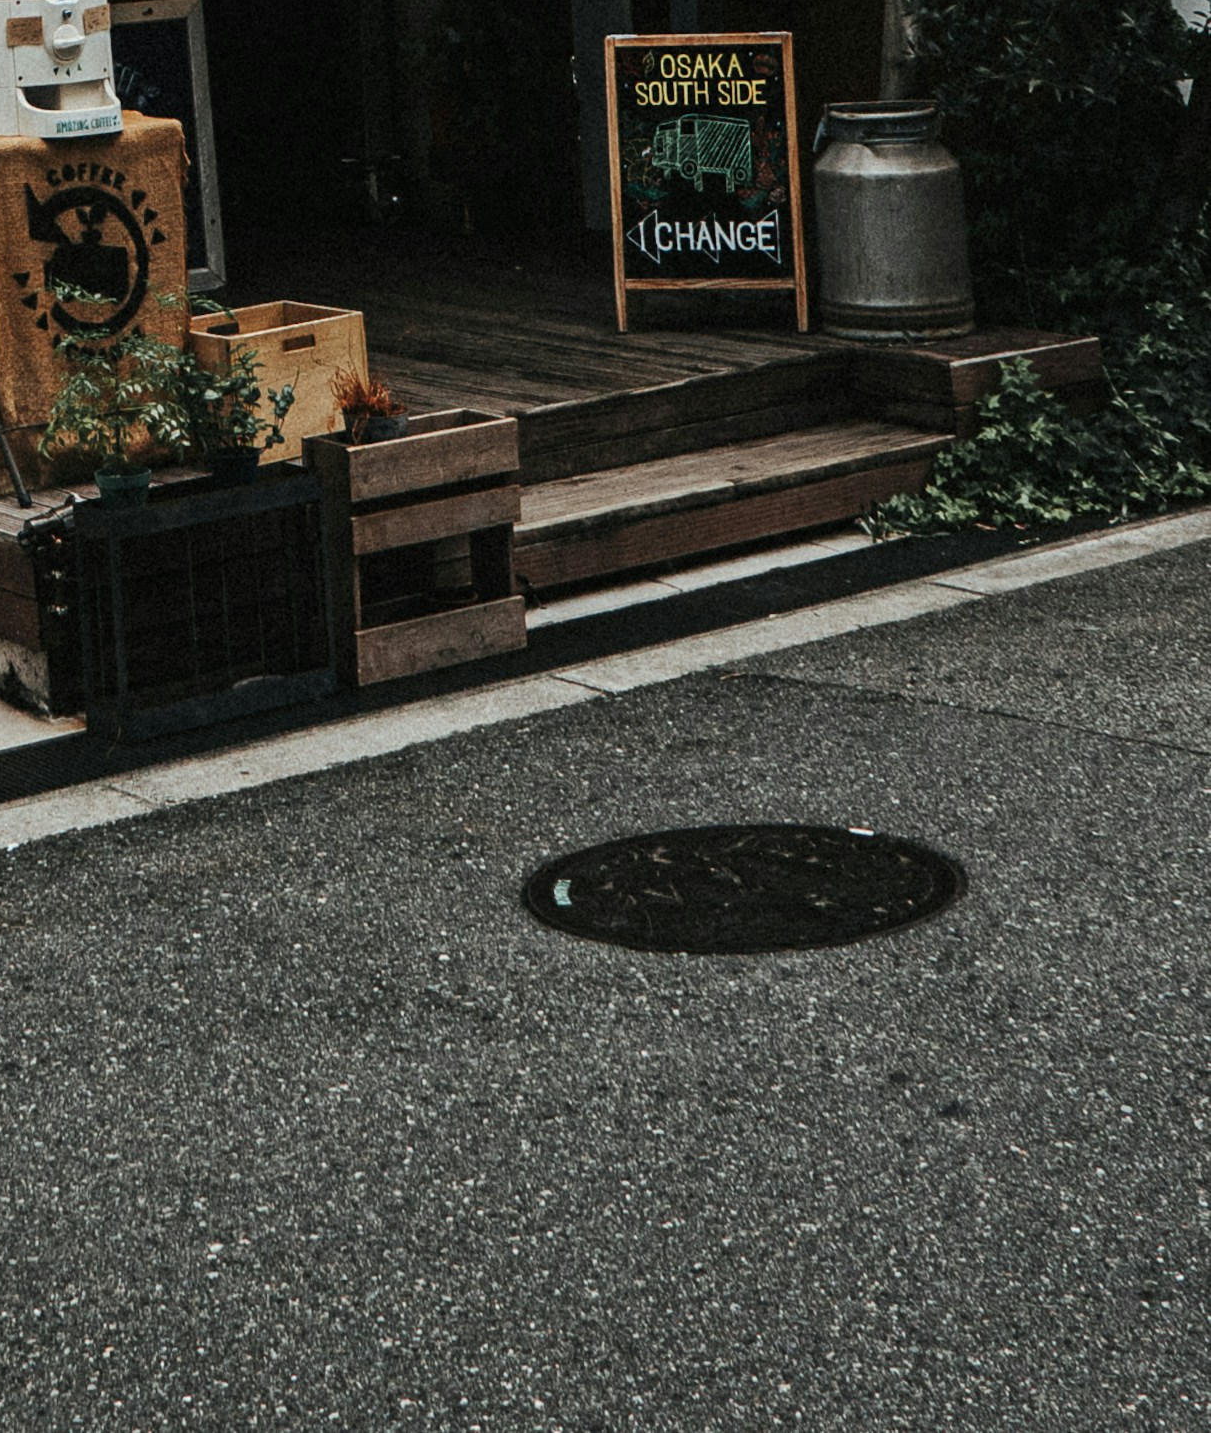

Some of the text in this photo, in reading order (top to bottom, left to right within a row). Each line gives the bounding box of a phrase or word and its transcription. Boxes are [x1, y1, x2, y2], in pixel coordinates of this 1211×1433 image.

[659, 52, 744, 80] OSAKA
[634, 78, 767, 106] SOUTH SIDE
[56, 116, 113, 134] AMAZING COFFEE
[46, 162, 126, 190] COFFEE
[655, 220, 776, 253] CHANGE
